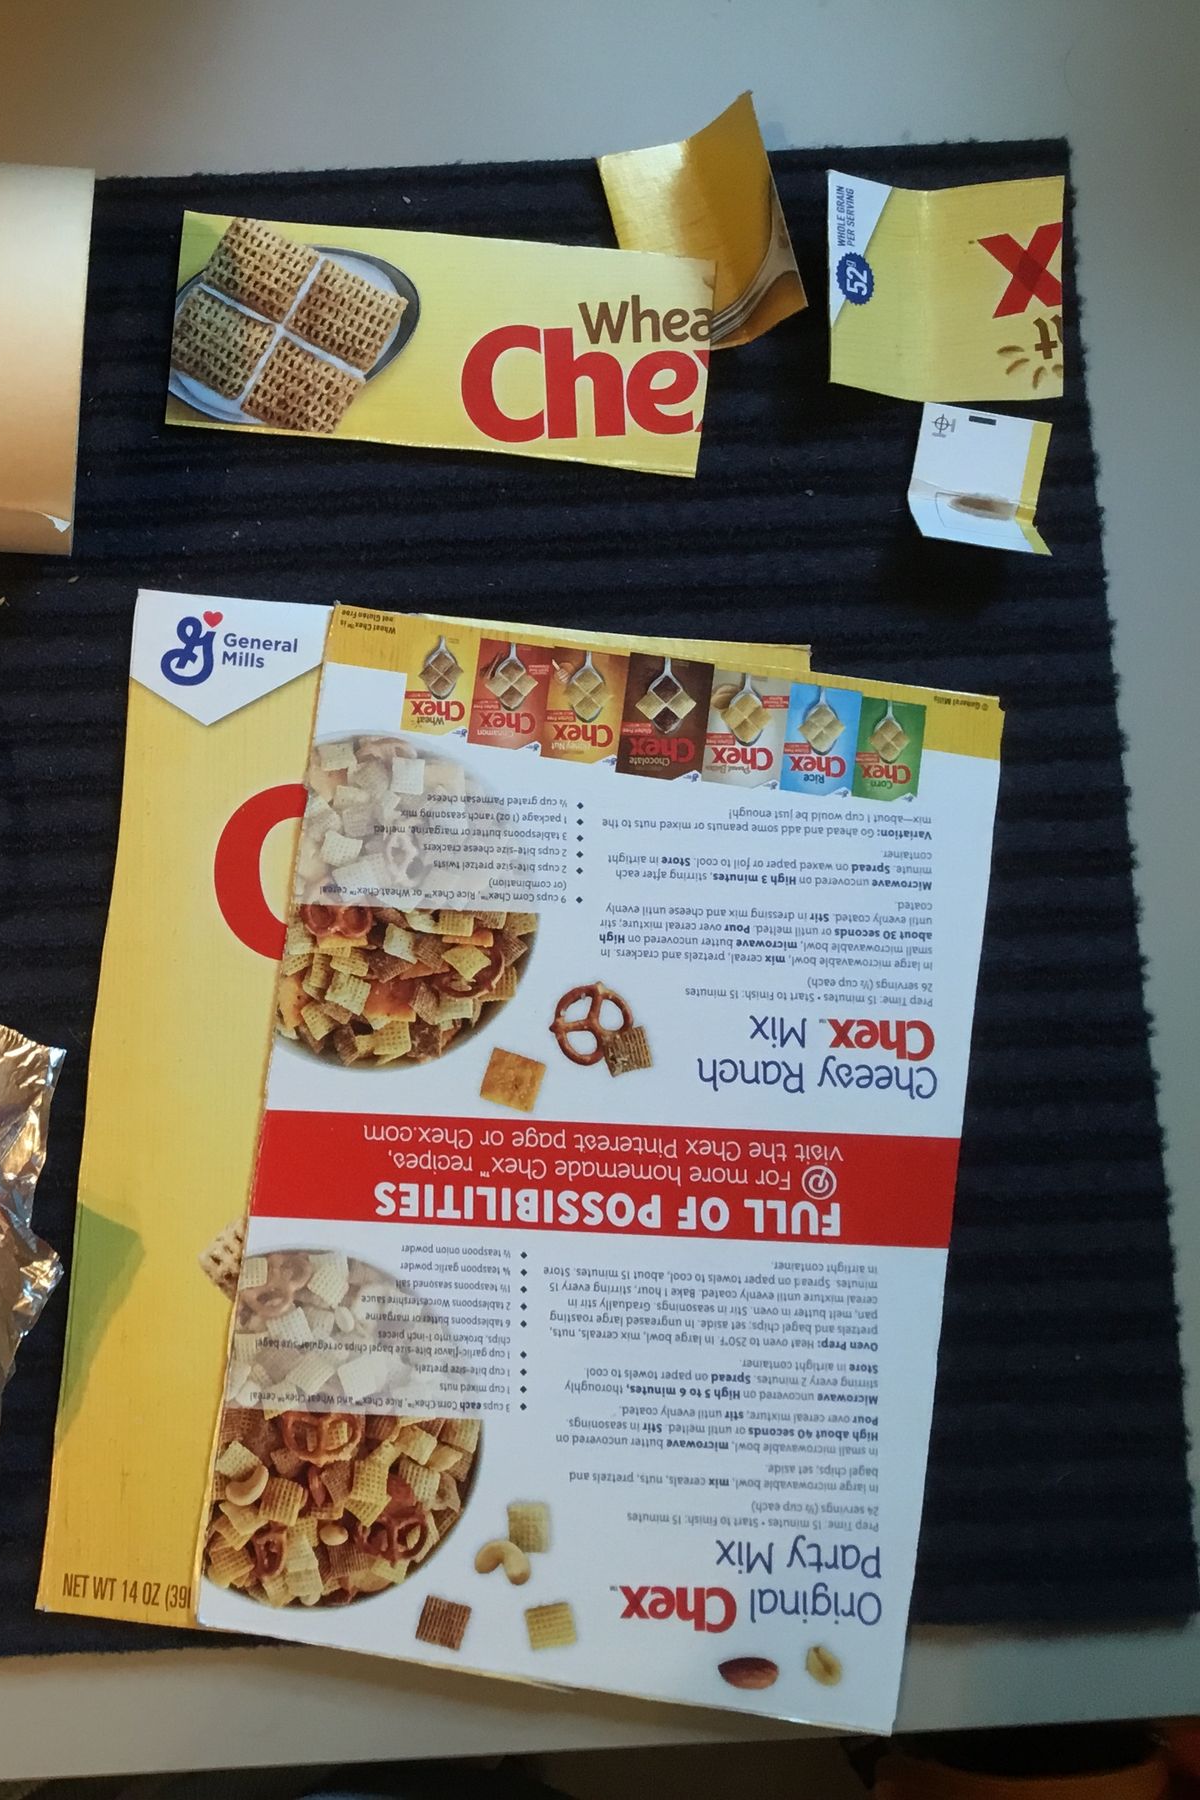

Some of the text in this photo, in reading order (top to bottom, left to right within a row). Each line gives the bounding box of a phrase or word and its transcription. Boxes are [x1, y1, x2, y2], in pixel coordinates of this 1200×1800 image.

[836, 186, 845, 246] WHOLE GRAIN
[846, 188, 855, 247] PER SERVING
[461, 324, 710, 443] Che
[342, 610, 356, 618] Free
[358, 612, 381, 621] Gluten
[373, 625, 396, 634] Wheat
[224, 633, 298, 653] General
[222, 652, 264, 668] Mills
[411, 701, 465, 721] Chex
[417, 717, 444, 725] Wheat
[480, 712, 535, 734] Chex
[553, 724, 613, 747] Chex
[630, 738, 695, 762] Chex
[629, 756, 670, 766] Chocolate
[712, 747, 773, 770] Chex
[790, 756, 846, 778] Chex
[804, 773, 824, 784] Rice
[859, 764, 911, 784] Chex
[871, 780, 892, 790] Corn
[729, 805, 773, 821] enough!
[774, 807, 794, 822] just
[795, 810, 809, 822] be
[811, 810, 844, 823] would
[844, 809, 865, 822] cup
[867, 812, 872, 824] 1
[602, 818, 620, 830] the
[621, 818, 632, 831] to
[634, 819, 658, 832] nuts
[659, 820, 692, 833] mixed
[694, 821, 706, 831] or
[706, 819, 750, 835] peanuts
[751, 823, 779, 833] some
[781, 824, 802, 836] add
[803, 824, 825, 837] and
[825, 825, 859, 838] ahead
[860, 826, 876, 839] Go
[433, 858, 568, 876] 2 cups bite-size pretzel twists
[615, 869, 641, 882] each
[642, 867, 668, 883] after
[669, 868, 708, 884] stirring
[761, 874, 768, 886] 3
[770, 872, 797, 887] High
[799, 875, 813, 885] on
[814, 876, 870, 889] uncovered
[872, 878, 933, 892] Microwave
[807, 975, 837, 991] each)
[837, 976, 859, 989] cup
[875, 977, 920, 993] servings
[921, 981, 933, 994] 26
[685, 987, 728, 1001] minutes
[729, 989, 740, 1001] 15
[776, 991, 788, 1003] to
[789, 991, 816, 1004] Start
[823, 992, 866, 1006] minutes
[867, 994, 878, 1006] 15
[909, 993, 934, 1008] Prep
[750, 1016, 806, 1048] Mix
[698, 1055, 937, 1099] Cheesy Ranch
[364, 1125, 843, 1164] visit the Chex Pinterest page or Chex.com
[388, 1150, 472, 1174] recipes,
[554, 1160, 681, 1186] homemade
[690, 1166, 748, 1183] more
[756, 1168, 791, 1190] For
[374, 1181, 841, 1236] FULL OF POSSIBILITIES
[564, 1379, 624, 1396] thoroughly
[679, 1386, 687, 1399] 6
[689, 1387, 703, 1399] to
[704, 1387, 711, 1399] 5
[714, 1385, 741, 1401] High
[743, 1389, 758, 1399] on
[758, 1389, 815, 1403] uncovered
[817, 1391, 879, 1406] Microwave
[629, 1421, 641, 1433] in
[642, 1421, 663, 1434] Stir
[707, 1424, 733, 1437] until
[735, 1425, 747, 1435] or
[748, 1425, 796, 1439] seconds
[797, 1427, 814, 1440] 40
[816, 1428, 850, 1441] about
[852, 1427, 879, 1443] High
[751, 1499, 782, 1515] each)
[782, 1500, 804, 1513] cup
[820, 1501, 866, 1517] servings
[867, 1506, 879, 1518] 24
[626, 1512, 671, 1526] minutes
[672, 1514, 682, 1526] 15
[720, 1516, 732, 1528] to
[733, 1516, 760, 1529] Start
[767, 1517, 810, 1531] minutes
[812, 1519, 822, 1531] 15
[855, 1518, 879, 1533] Prep
[716, 1535, 881, 1578] Party Mix
[62, 1573, 89, 1598] NET
[93, 1576, 116, 1601] WT
[122, 1580, 137, 1604] 14
[143, 1582, 160, 1605] OZ
[750, 1583, 881, 1626] Original
